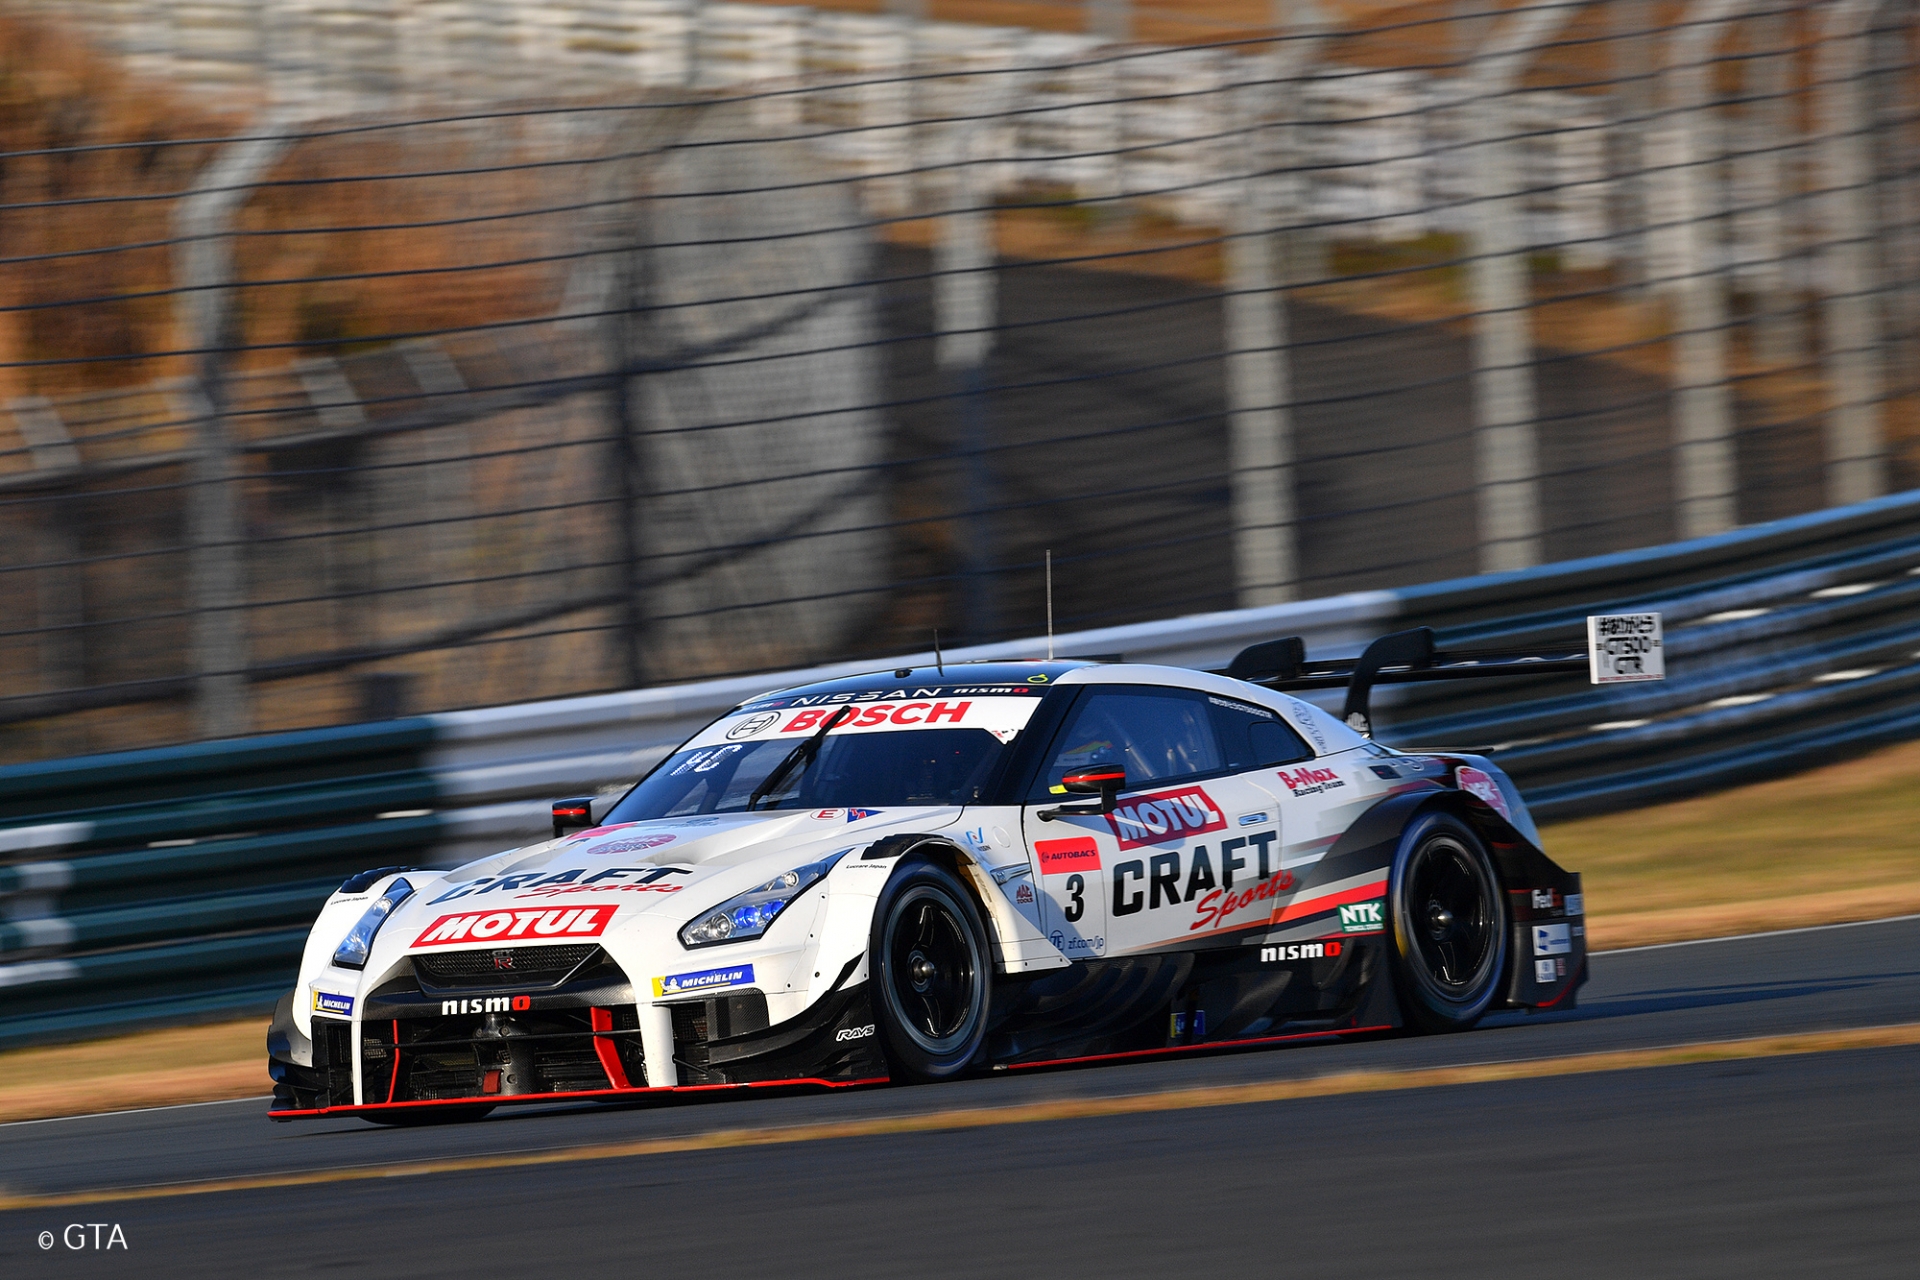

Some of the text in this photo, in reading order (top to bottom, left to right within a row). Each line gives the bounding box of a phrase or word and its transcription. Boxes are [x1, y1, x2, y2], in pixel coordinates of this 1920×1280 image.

[790, 687, 943, 707] NISSAN
[780, 701, 973, 734] BOSCH
[1277, 767, 1340, 790] B-Max
[1293, 780, 1347, 797] Racing Team
[1112, 793, 1220, 842] MOTUL
[1051, 849, 1096, 860] AUTOBACS
[1112, 830, 1277, 917] CRAFT
[426, 867, 694, 906] CRAFT
[1065, 873, 1085, 922] 3
[1190, 869, 1296, 931] Sports
[1340, 903, 1382, 924] NTK
[421, 908, 600, 943] MOTUL
[1260, 942, 1341, 962] nismo
[681, 970, 743, 988] MICHELIN
[323, 998, 351, 1010] MICHELIN
[441, 995, 531, 1016] nismo
[836, 1024, 875, 1042] RAYS
